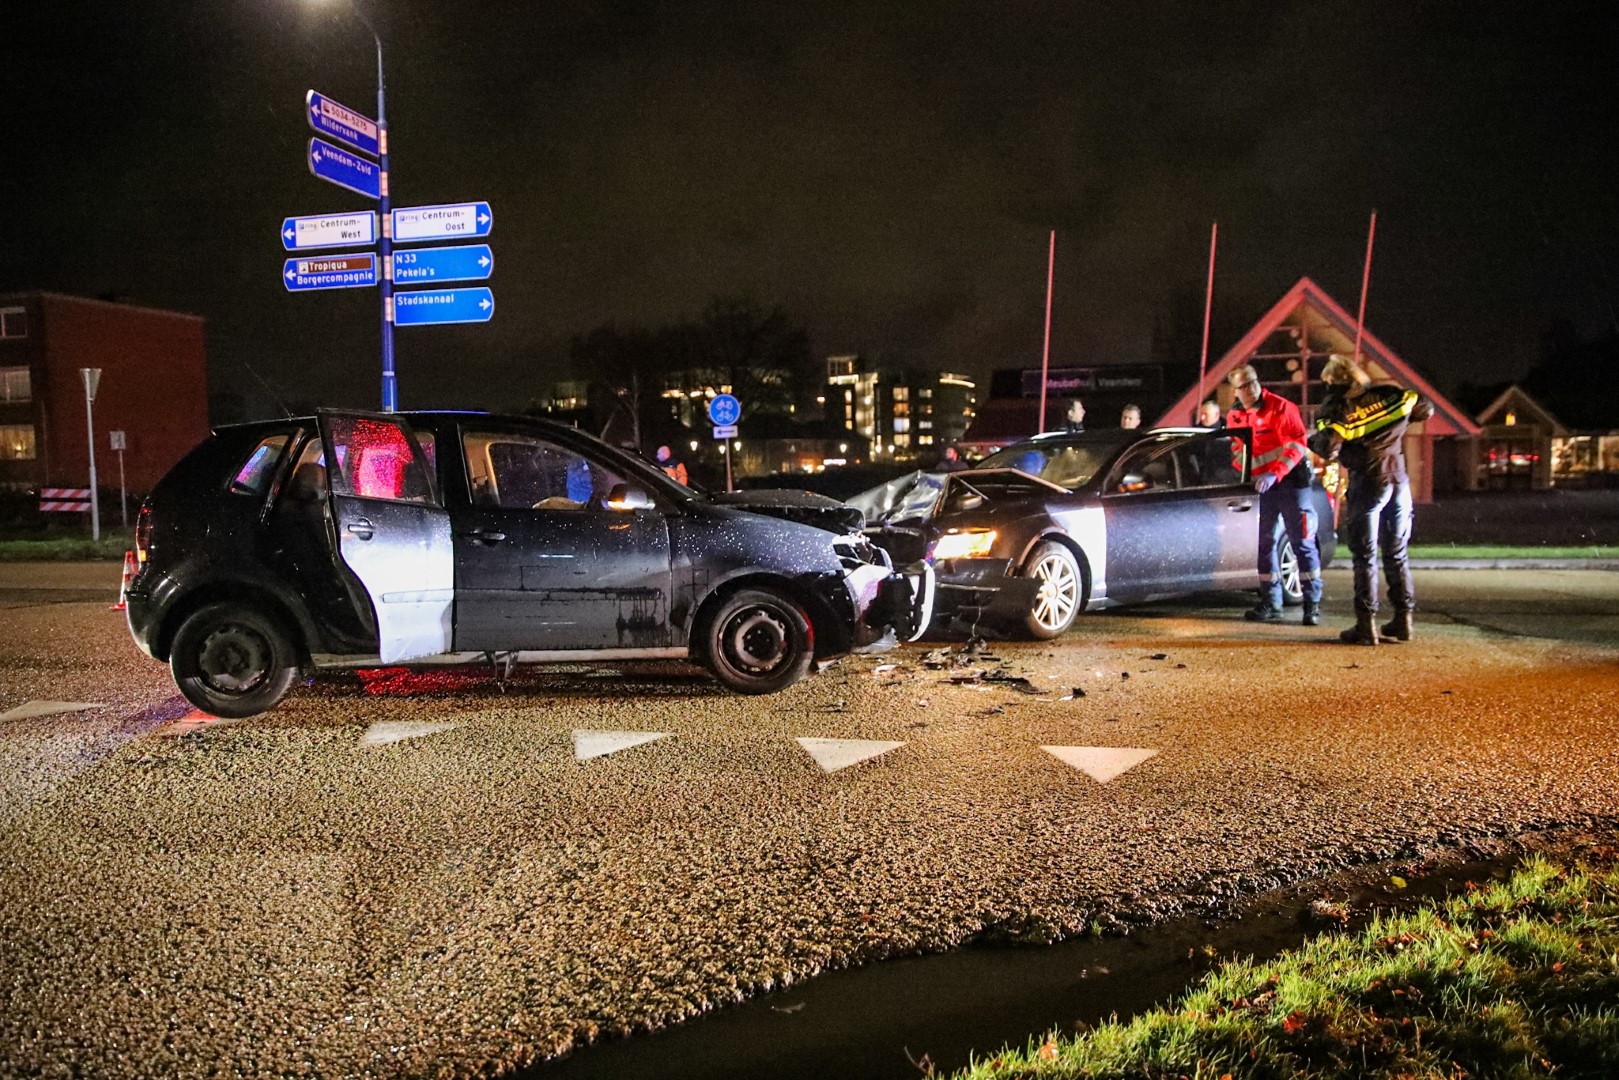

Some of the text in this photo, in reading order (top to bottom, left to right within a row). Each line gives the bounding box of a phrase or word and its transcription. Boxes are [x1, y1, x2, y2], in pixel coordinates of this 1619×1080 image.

[321, 115, 358, 140] Wildervank
[321, 146, 372, 175] Veendam-Zuid
[422, 211, 465, 220] Centrum-
[320, 219, 361, 229] Centrum-
[445, 222, 465, 231] Oost
[341, 230, 361, 239] West
[396, 253, 417, 264] N 33
[309, 261, 347, 271] Tropiqua
[396, 266, 435, 278] Pekela's
[297, 271, 374, 287] Borgercompagnie
[397, 294, 455, 306] Stadskanaal
